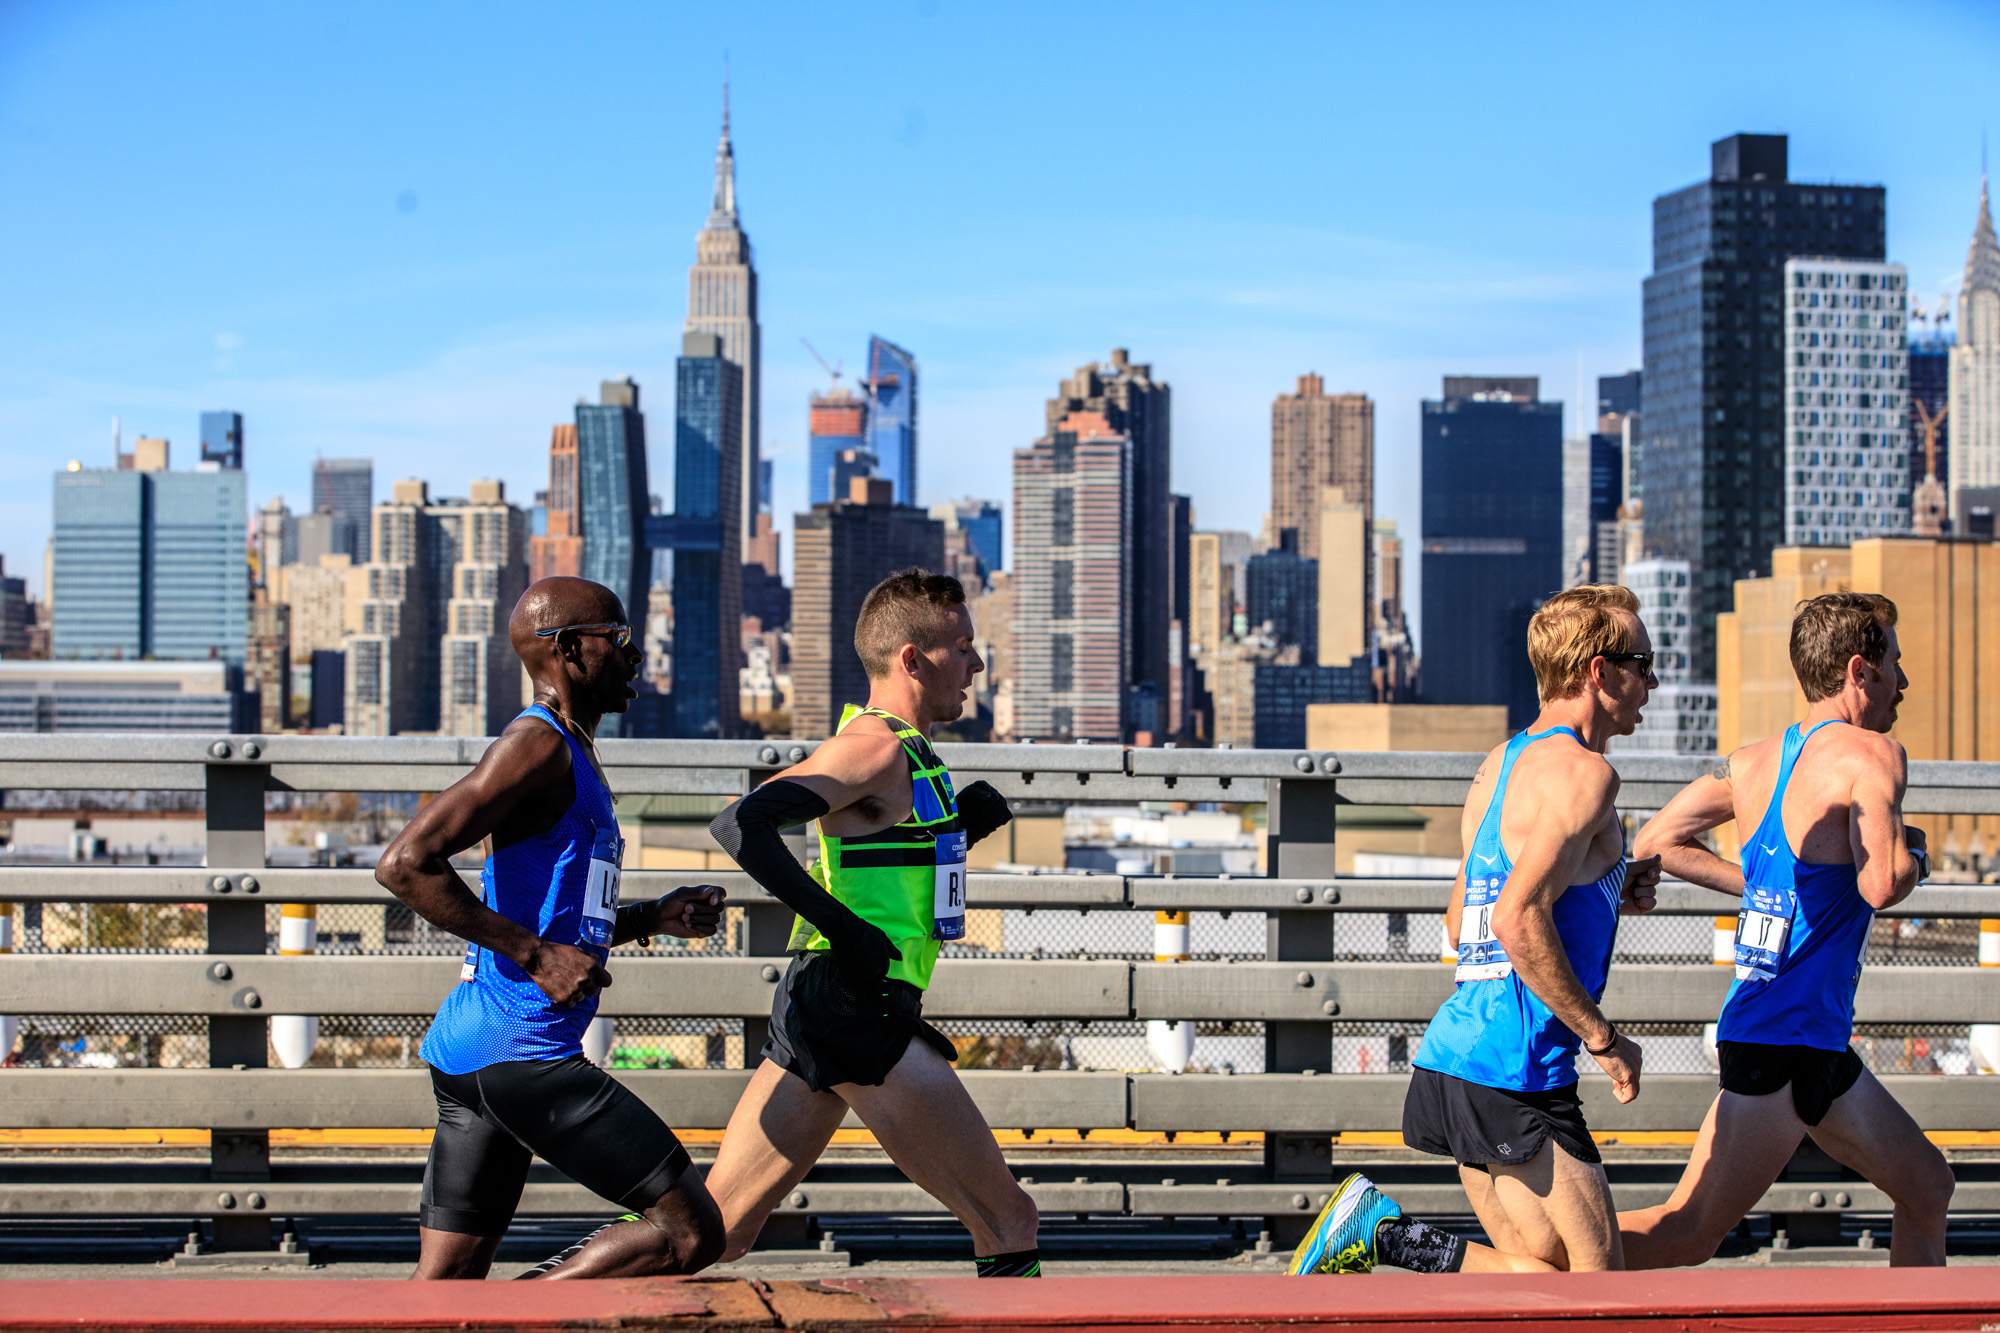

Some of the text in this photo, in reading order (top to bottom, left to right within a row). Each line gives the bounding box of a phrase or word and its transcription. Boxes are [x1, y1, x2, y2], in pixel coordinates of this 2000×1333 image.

[1478, 906, 1489, 940] 18
[1758, 915, 1773, 946] 17
[1461, 943, 1494, 963] 2018
